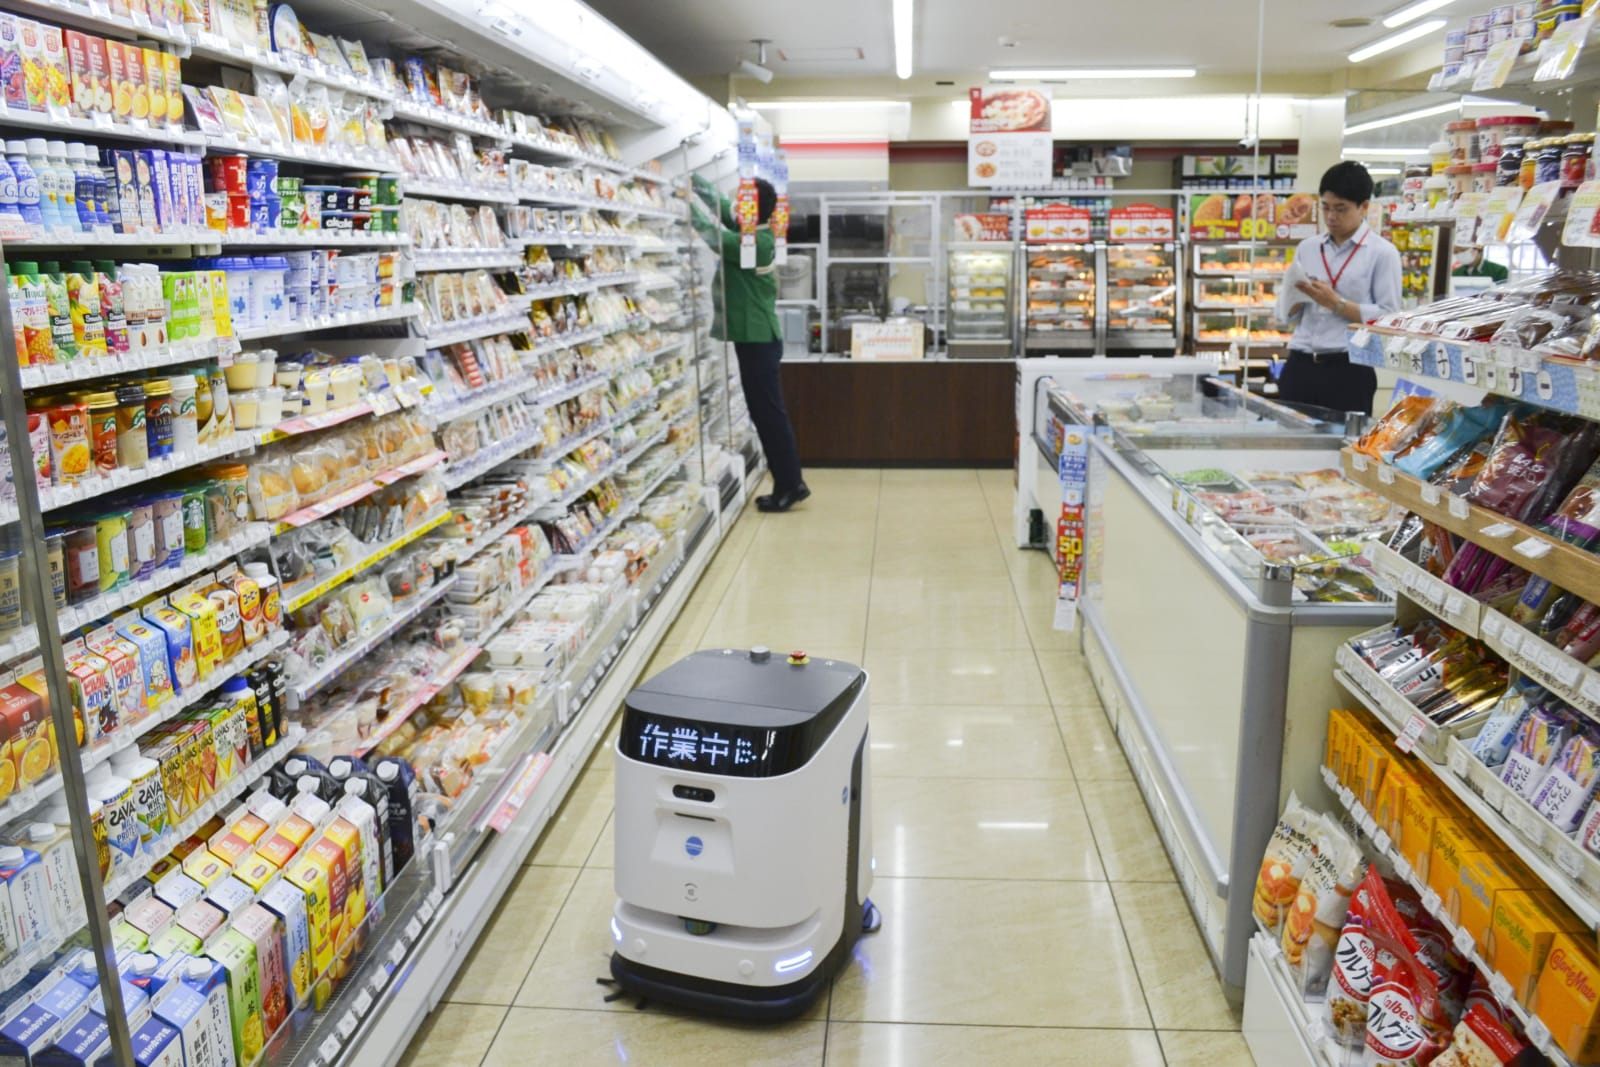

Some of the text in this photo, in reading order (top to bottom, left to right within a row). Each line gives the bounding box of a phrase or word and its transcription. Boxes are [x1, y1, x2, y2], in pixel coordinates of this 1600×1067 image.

[1240, 218, 1268, 239] 80
[1059, 536, 1082, 554] 50
[1418, 667, 1441, 682] in
[138, 781, 164, 805] SAVA
[109, 799, 136, 827] SAVA
[1358, 938, 1376, 964] Calb
[1549, 948, 1597, 1003] CalorieMate
[1367, 1001, 1425, 1048] フルグラ
